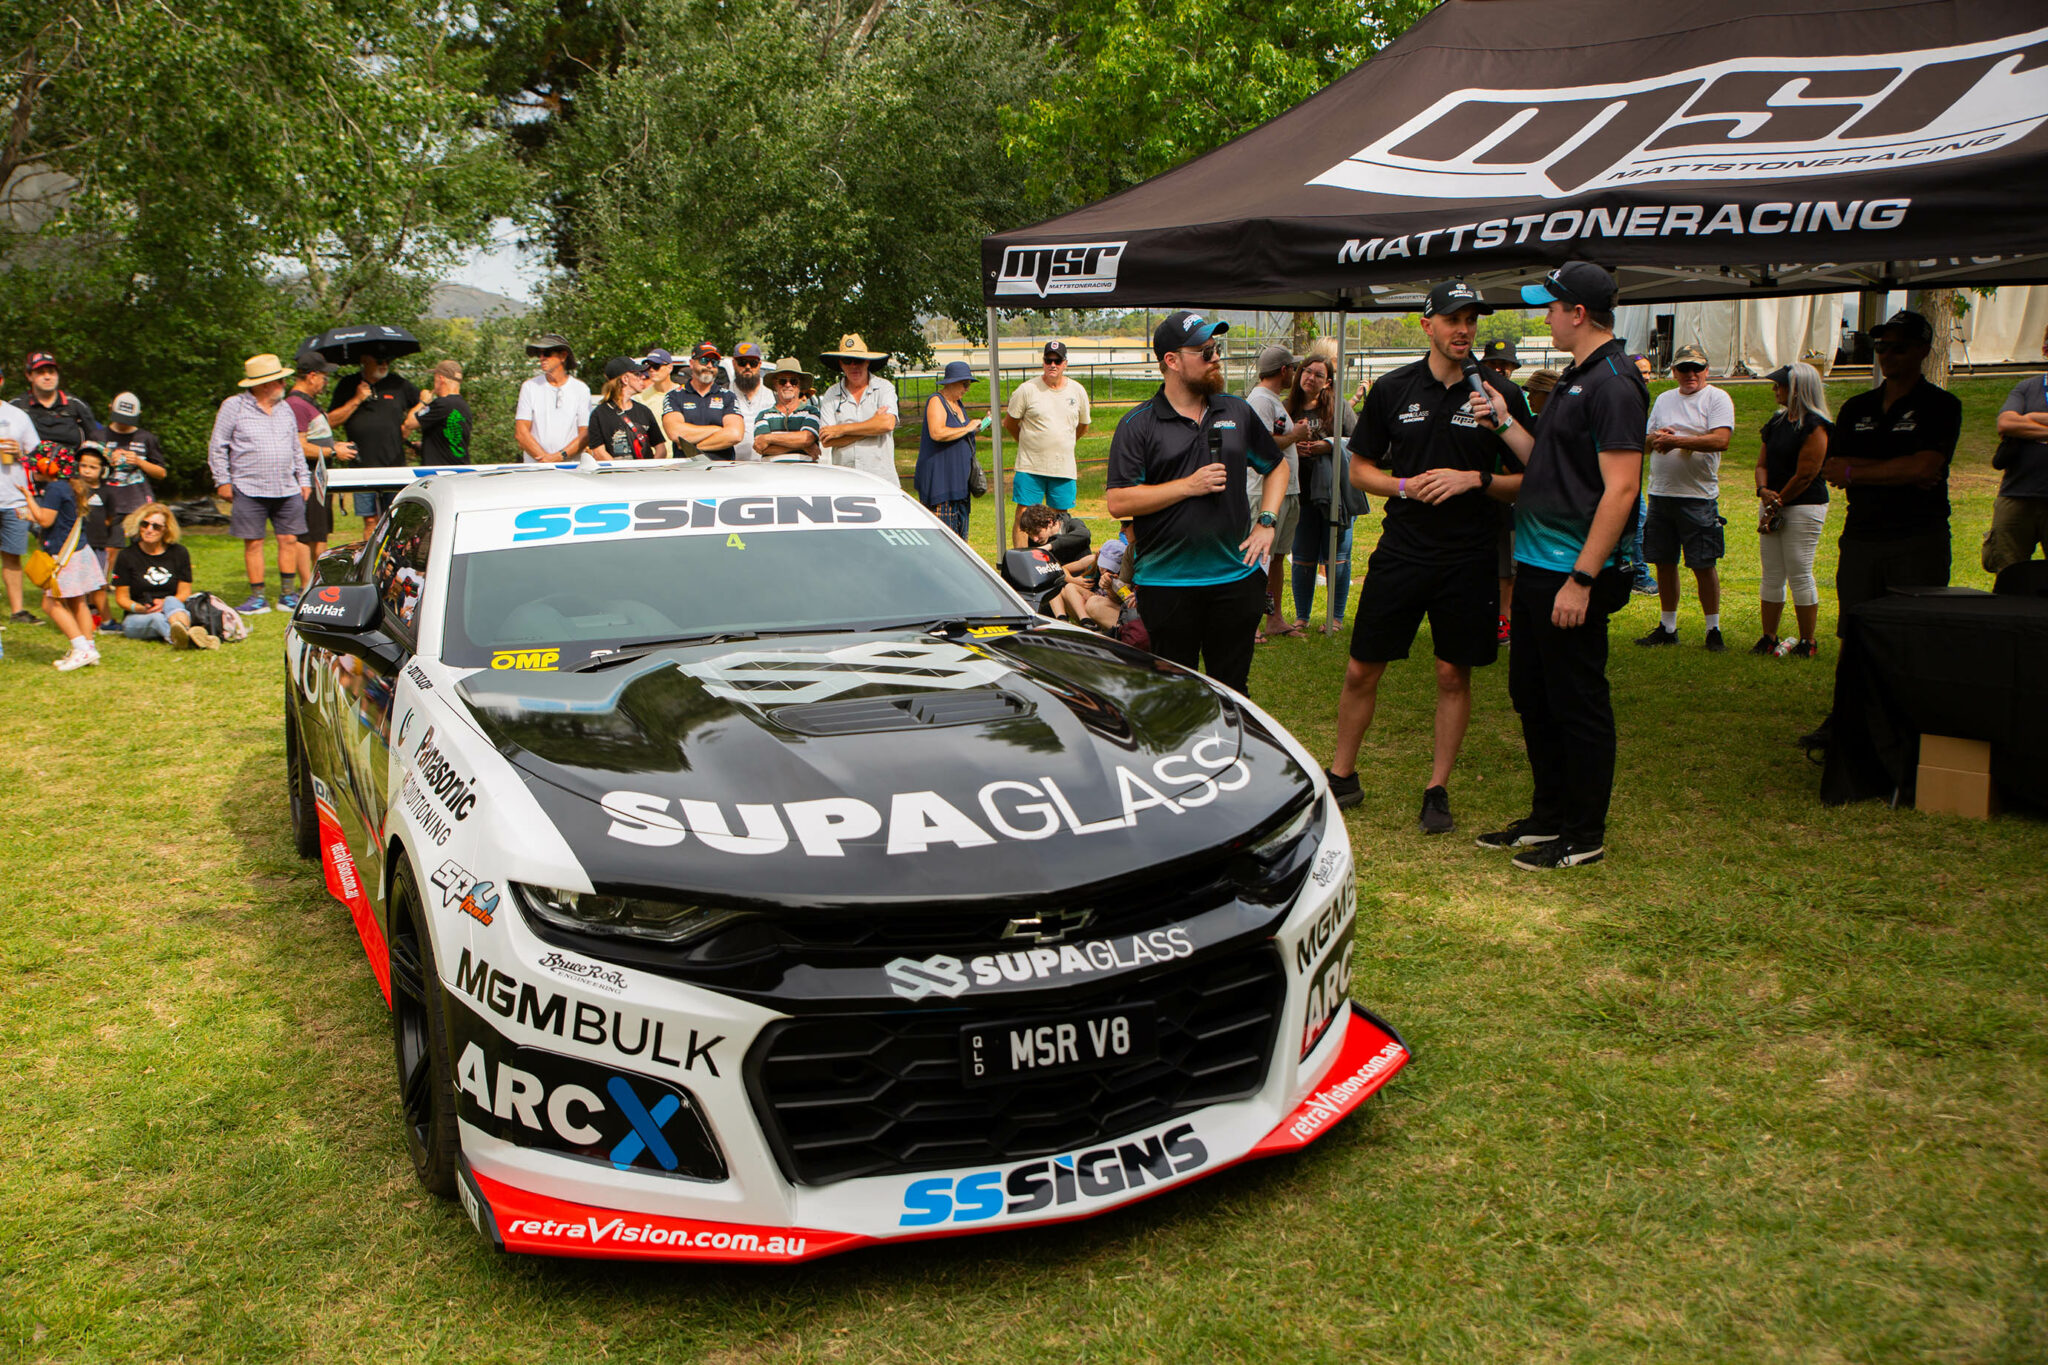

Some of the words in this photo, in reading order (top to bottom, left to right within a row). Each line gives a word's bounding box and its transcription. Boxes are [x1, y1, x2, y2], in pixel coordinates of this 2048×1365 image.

[1608, 133, 2004, 180] MATTSTONERACING
[1337, 199, 1911, 265] MATTSTONERACING
[726, 533, 746, 551] 4
[877, 529, 931, 546] Hill
[300, 603, 321, 616] Red
[321, 604, 345, 617] Hat
[407, 665, 433, 690] DUNLOP
[491, 652, 560, 671] OMP
[414, 725, 477, 822] Panasonic
[600, 736, 1251, 857] SUPAGLASS
[330, 842, 359, 899] retraVision.com.au
[538, 952, 587, 972] Bruce
[588, 965, 628, 989] Rock
[970, 926, 1194, 986] SUPAGLASS
[557, 971, 621, 994] ENGINEERING
[456, 947, 726, 1078] MGMBULK
[1011, 1024, 1078, 1070] MSR
[1087, 1017, 1130, 1058] V8
[1290, 1042, 1403, 1142] retraVision.com.au
[508, 1216, 805, 1257] retraVision.com.au
